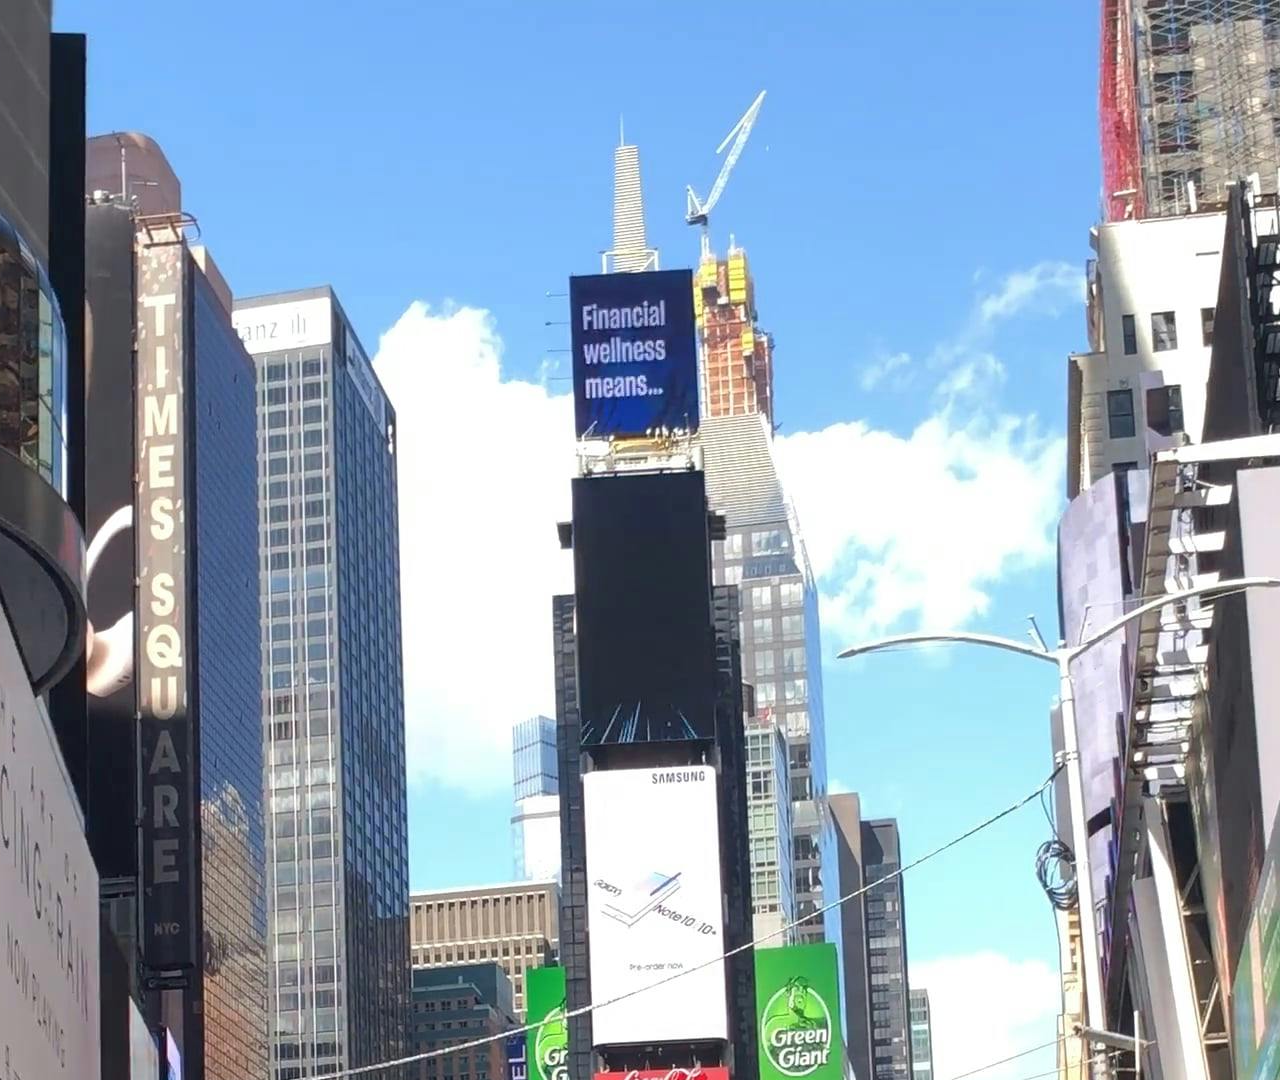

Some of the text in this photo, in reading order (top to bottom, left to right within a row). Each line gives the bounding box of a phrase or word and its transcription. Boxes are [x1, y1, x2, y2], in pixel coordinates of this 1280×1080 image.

[582, 300, 666, 331] Financial
[583, 337, 666, 364] wellness
[585, 374, 663, 399] means...
[143, 295, 182, 884] TIMES SQUARE
[652, 770, 705, 785] SAMSUNG
[771, 1028, 827, 1047] Green
[779, 1047, 830, 1068] Giant
